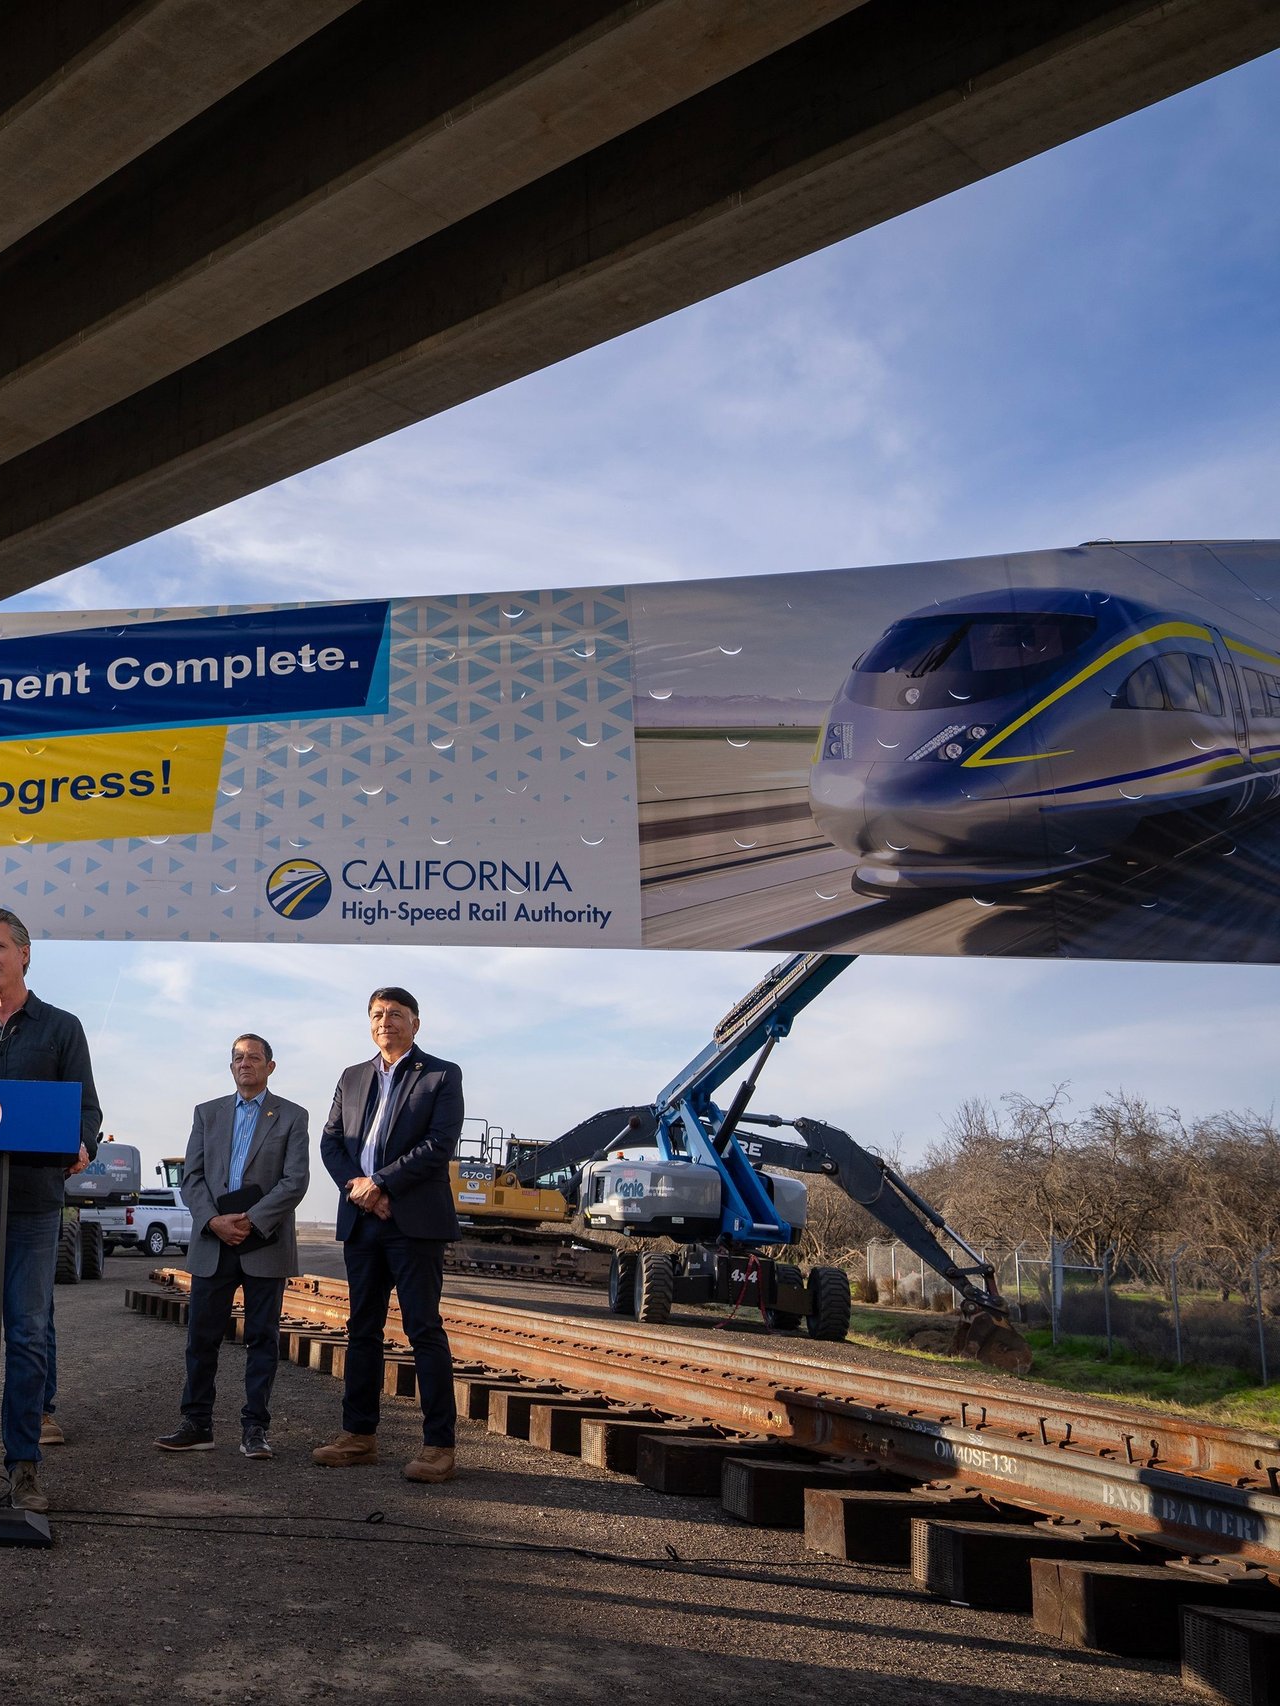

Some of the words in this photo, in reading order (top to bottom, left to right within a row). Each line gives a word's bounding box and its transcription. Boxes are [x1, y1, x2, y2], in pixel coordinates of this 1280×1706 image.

[106, 643, 360, 690] Complete.
[340, 859, 573, 894] CALIFORNIA
[340, 901, 462, 926] High-Speed
[468, 902, 508, 923] Rail
[514, 903, 613, 930] Authority
[461, 1171, 492, 1181] 470G
[615, 1177, 644, 1197] Genie
[731, 1268, 758, 1284] 4x4
[1101, 1483, 1154, 1515] BNSF
[1205, 1508, 1266, 1544] CERT
